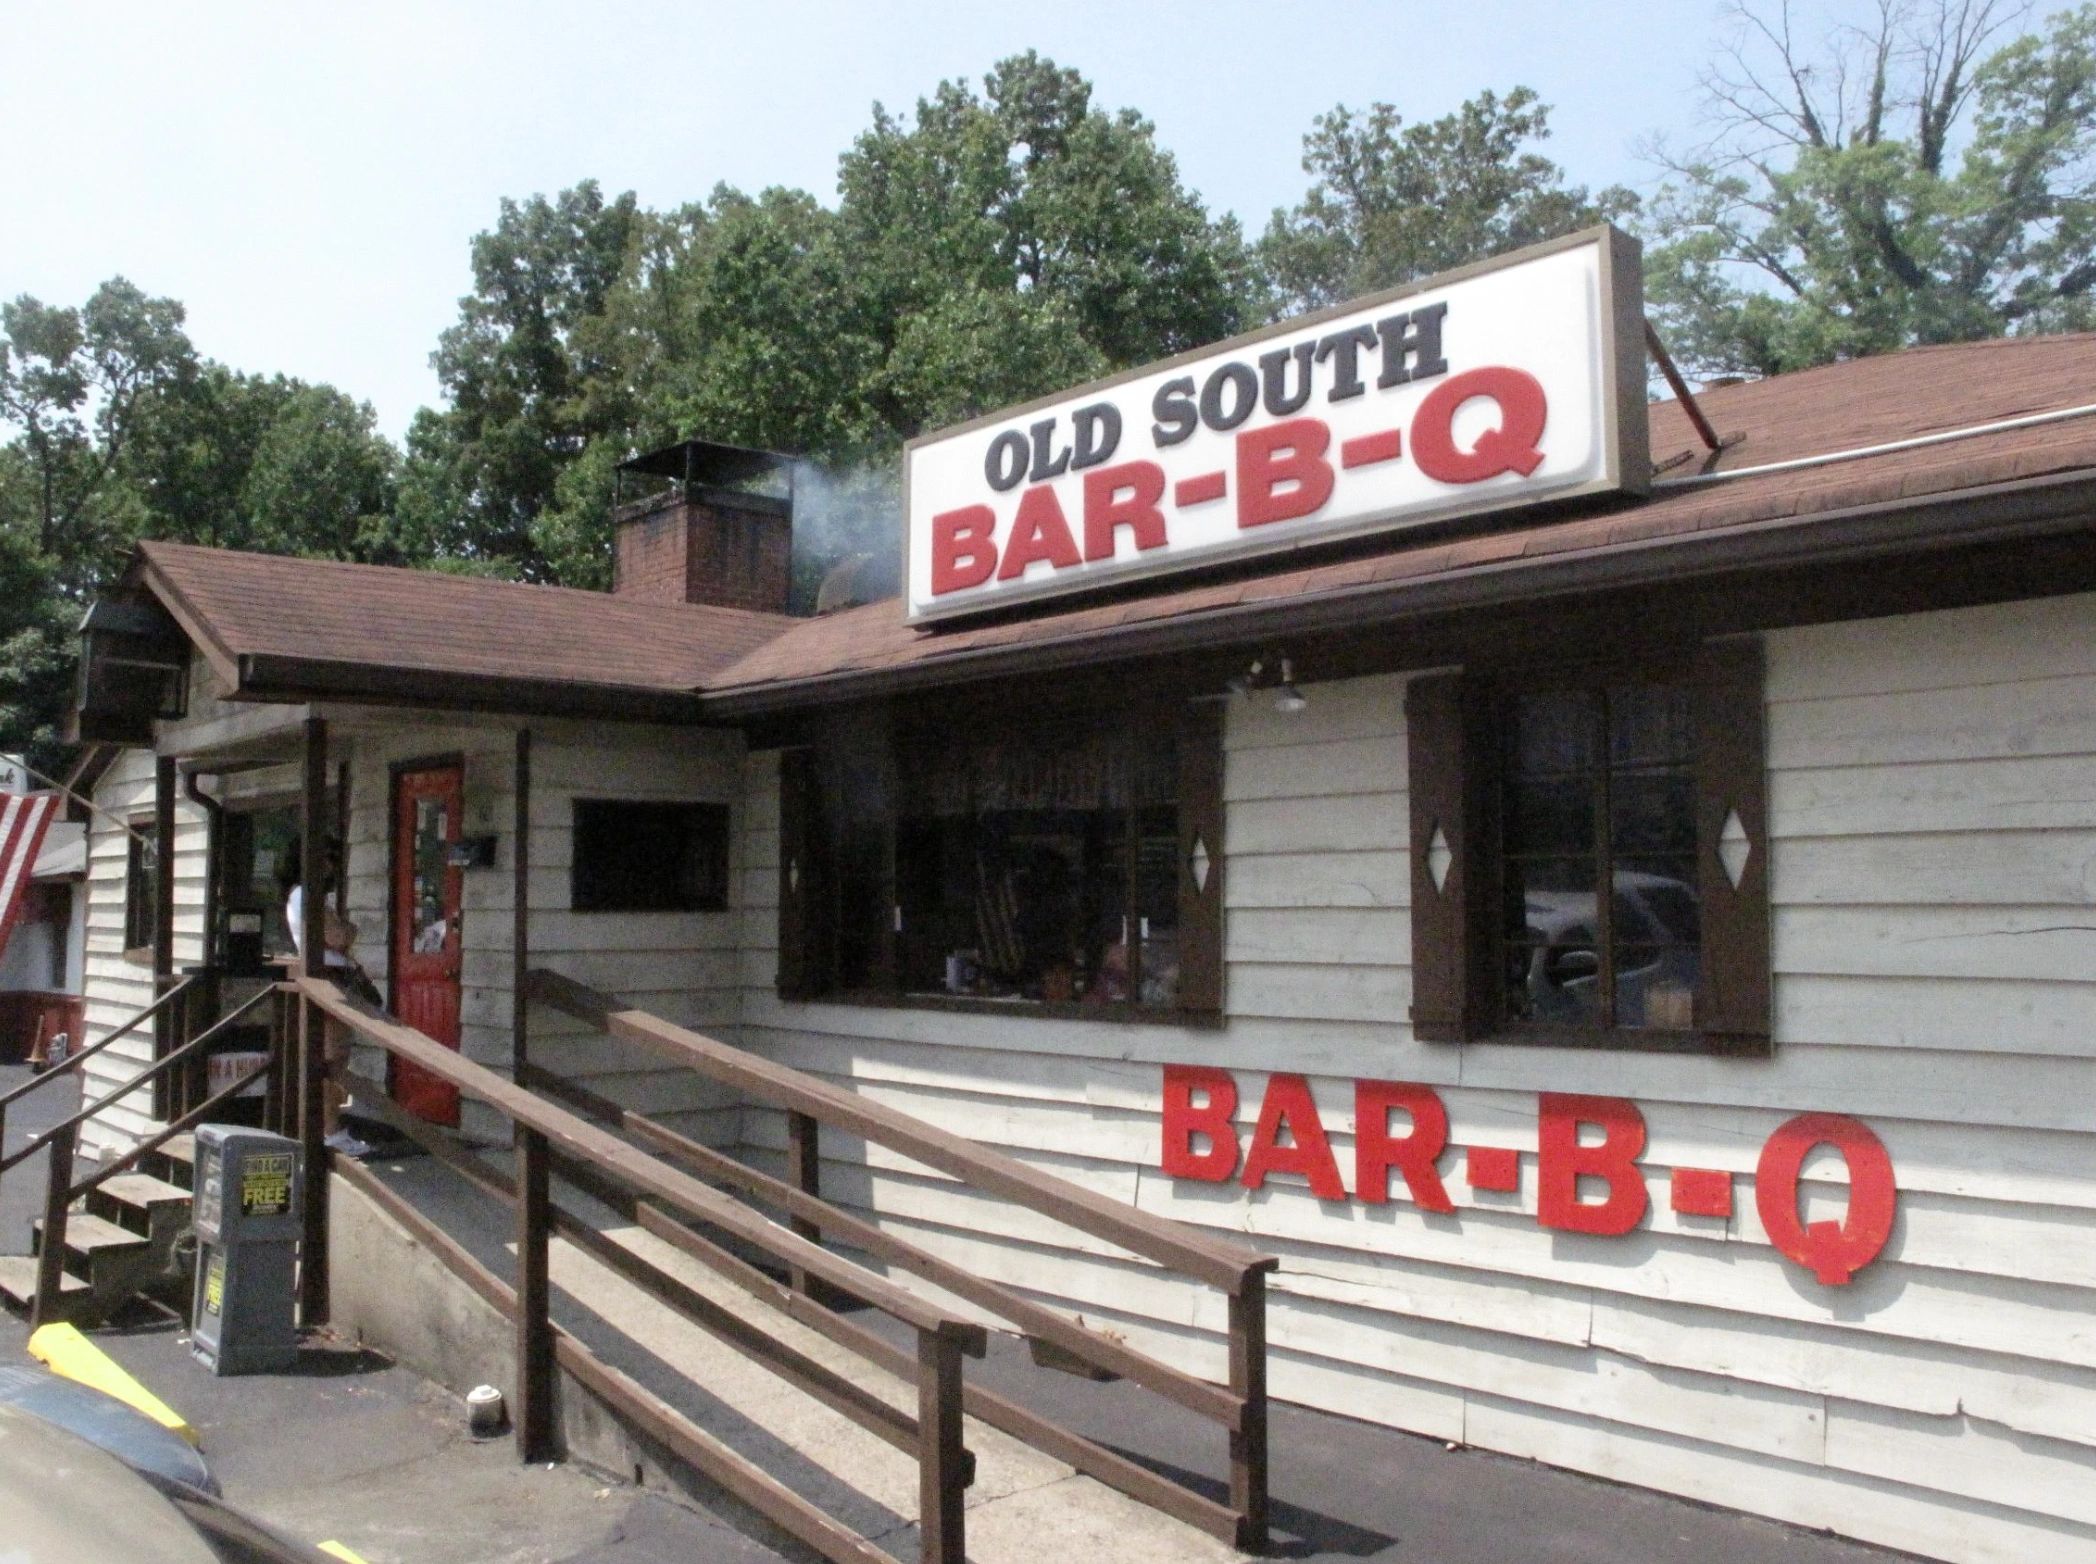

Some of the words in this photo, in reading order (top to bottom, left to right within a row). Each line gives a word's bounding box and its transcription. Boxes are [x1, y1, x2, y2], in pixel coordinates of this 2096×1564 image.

[930, 365, 1548, 596] BAR-B-Q
[985, 402, 1123, 493] OLD
[1152, 302, 1449, 449] SOUTH
[243, 1187, 287, 1205] FREE
[1159, 1063, 1898, 1287] BAR-B-Q
